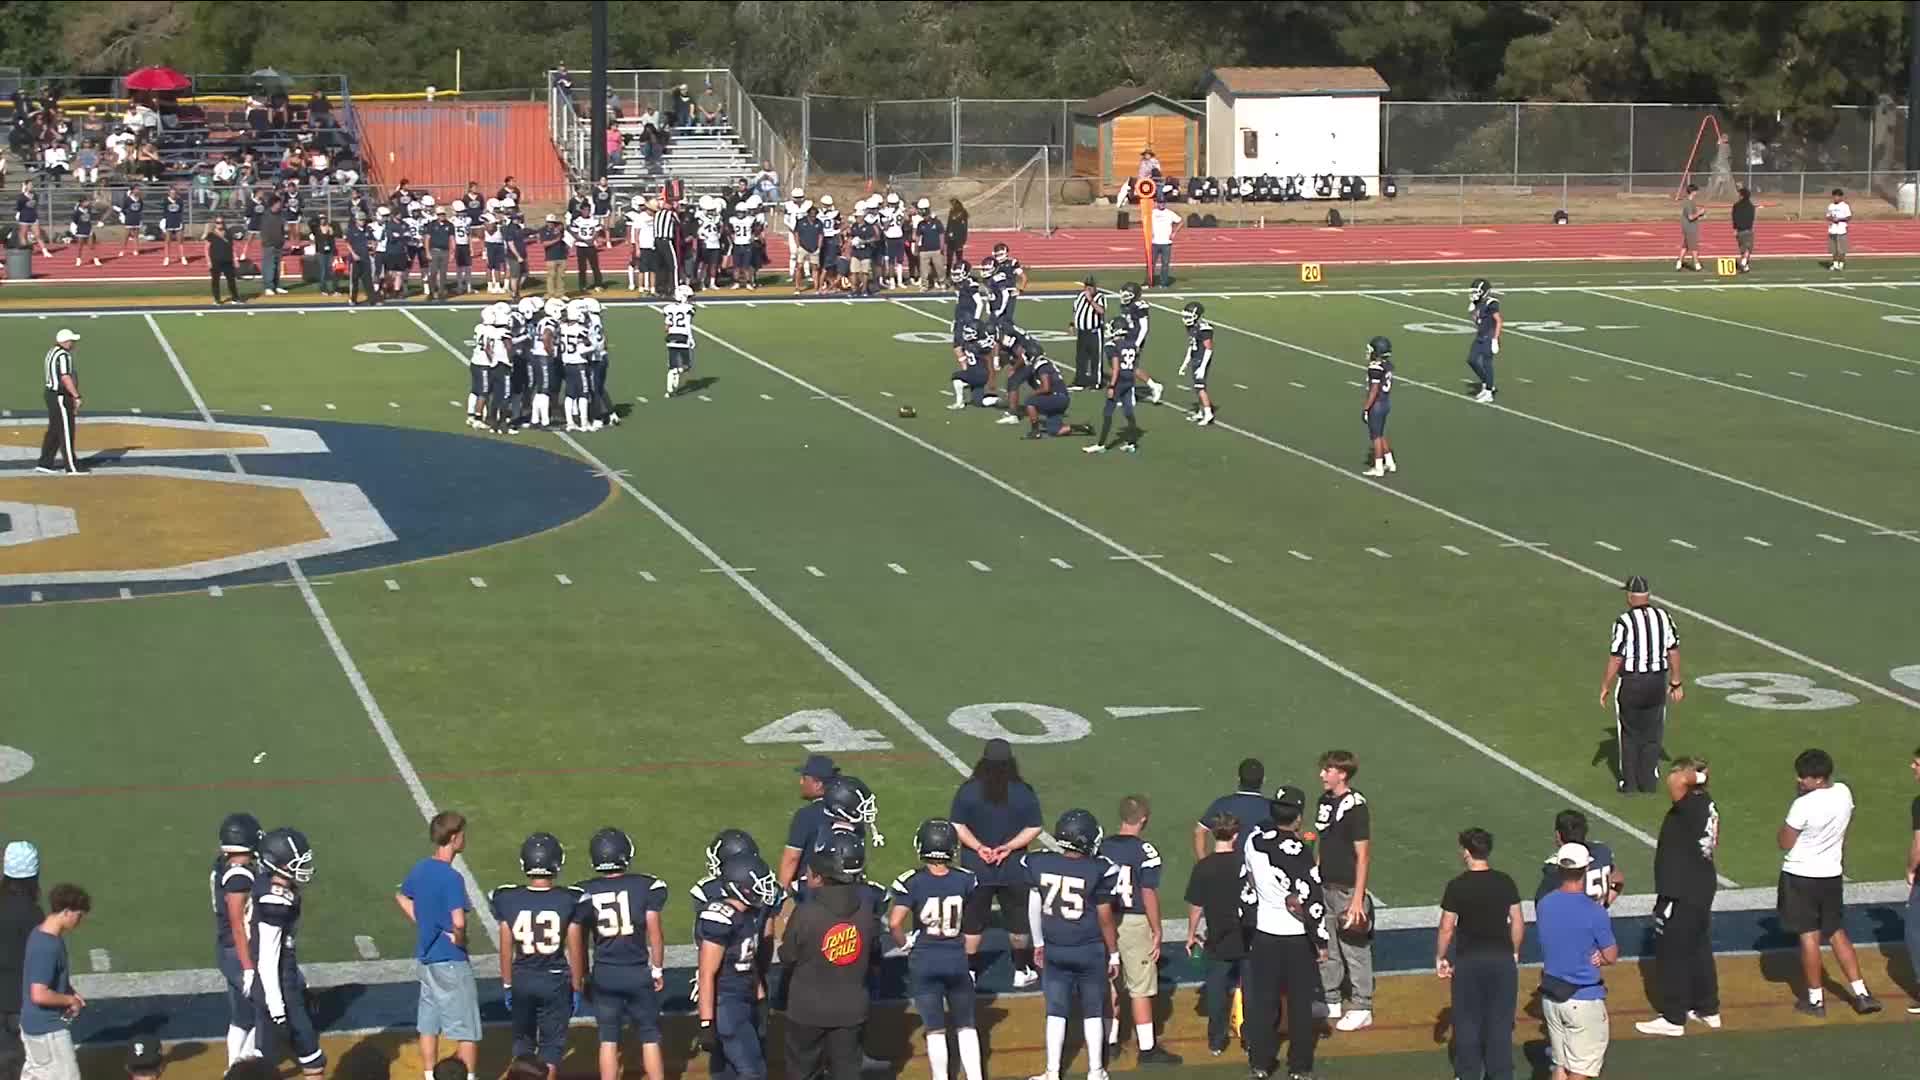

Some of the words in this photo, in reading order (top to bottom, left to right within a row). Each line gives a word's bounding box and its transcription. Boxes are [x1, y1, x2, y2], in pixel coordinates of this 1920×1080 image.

[735, 226, 747, 237] 21
[1304, 266, 1319, 281] 20
[1720, 260, 1734, 274] 10
[1040, 873, 1085, 920] 75
[591, 890, 635, 936] 51
[920, 895, 964, 937] 40
[512, 910, 561, 954] 43
[821, 925, 857, 951] SANTA
[828, 940, 856, 962] CRUZ
